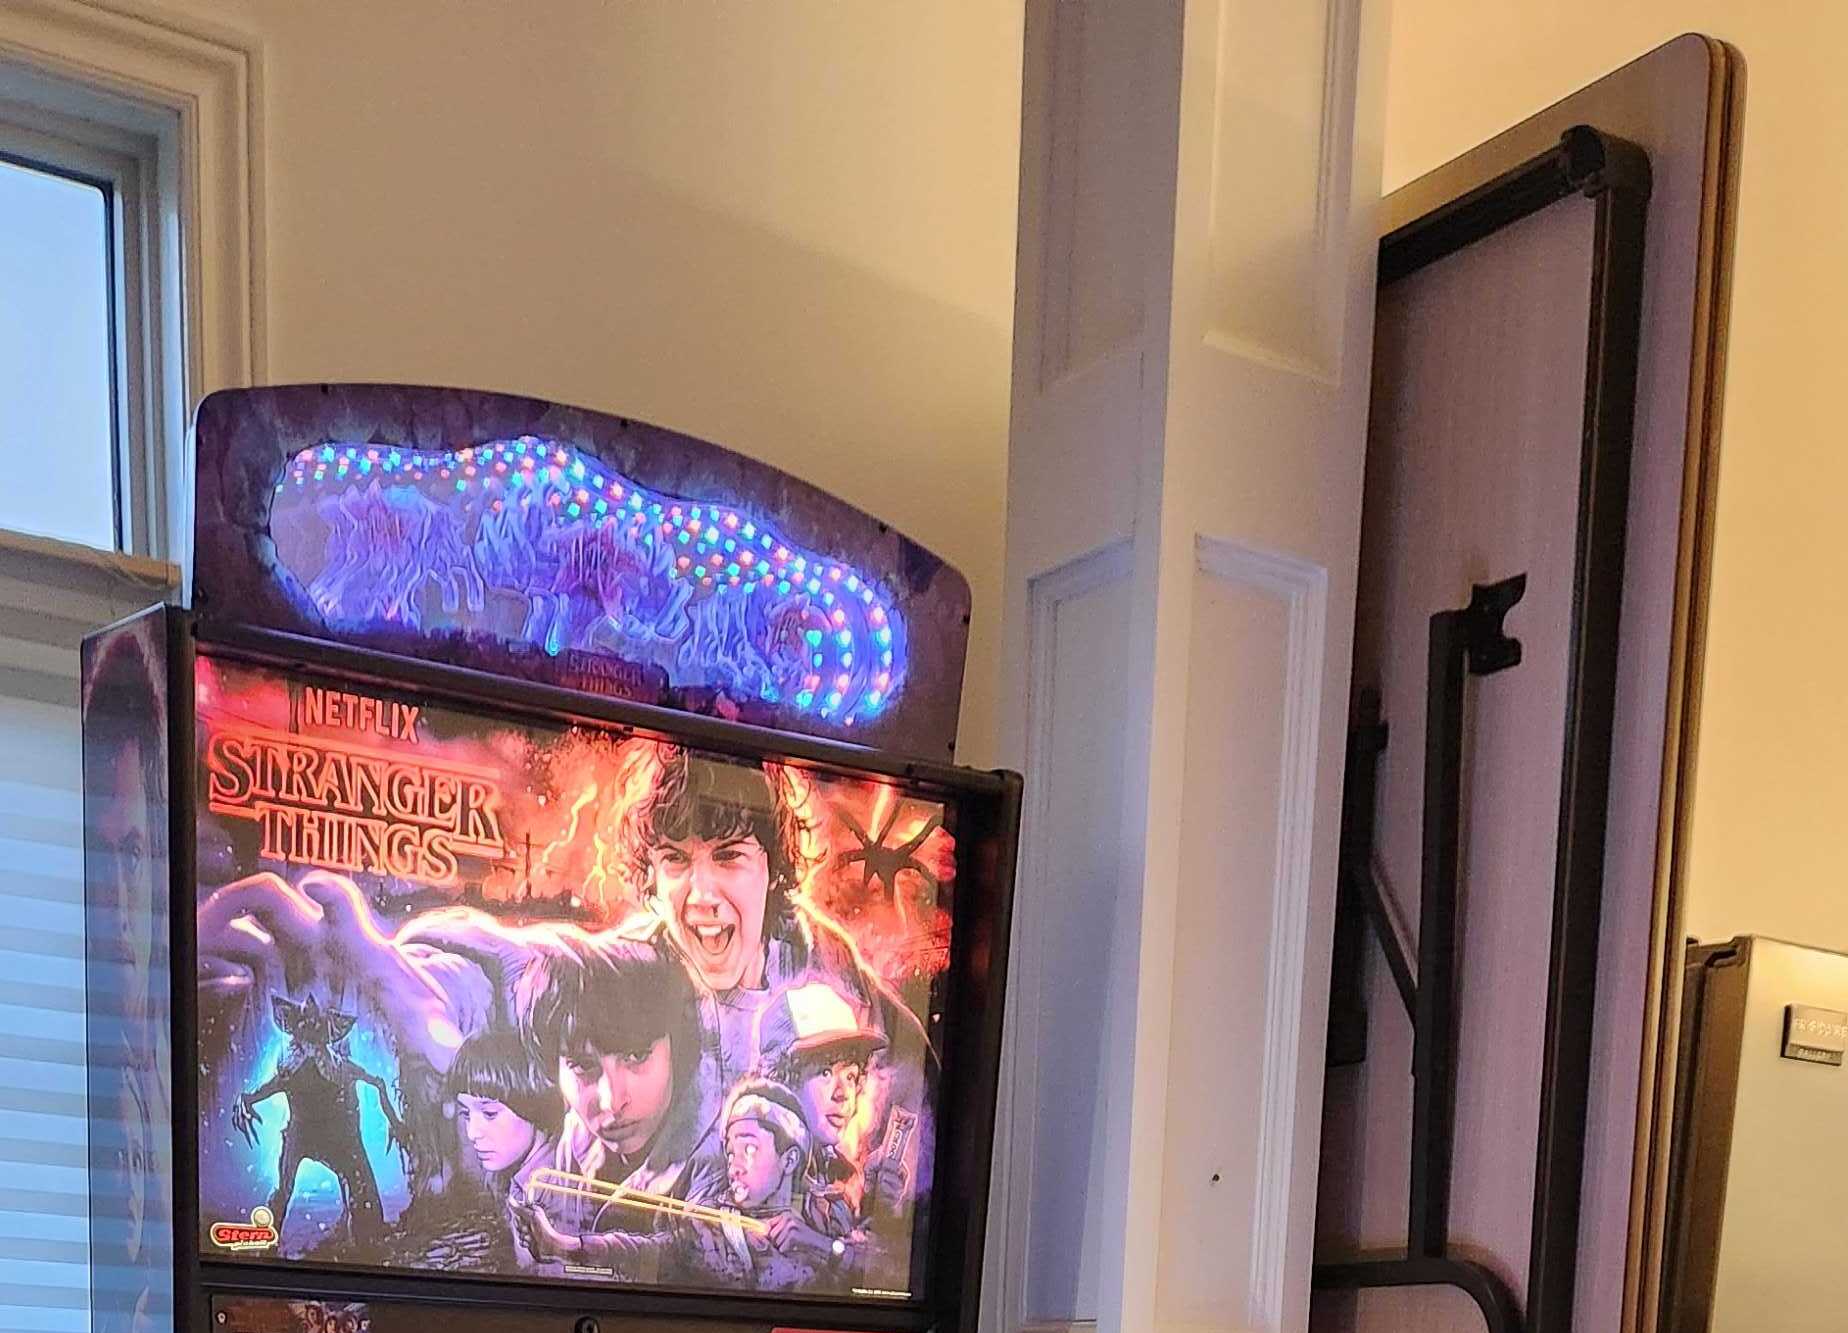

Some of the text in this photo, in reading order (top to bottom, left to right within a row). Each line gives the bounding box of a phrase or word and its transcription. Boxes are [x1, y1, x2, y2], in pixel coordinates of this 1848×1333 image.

[304, 686, 419, 744] NETFLIX
[208, 734, 504, 848] STRANGER
[256, 803, 459, 883] THINGS
[217, 1228, 274, 1243] Stern
